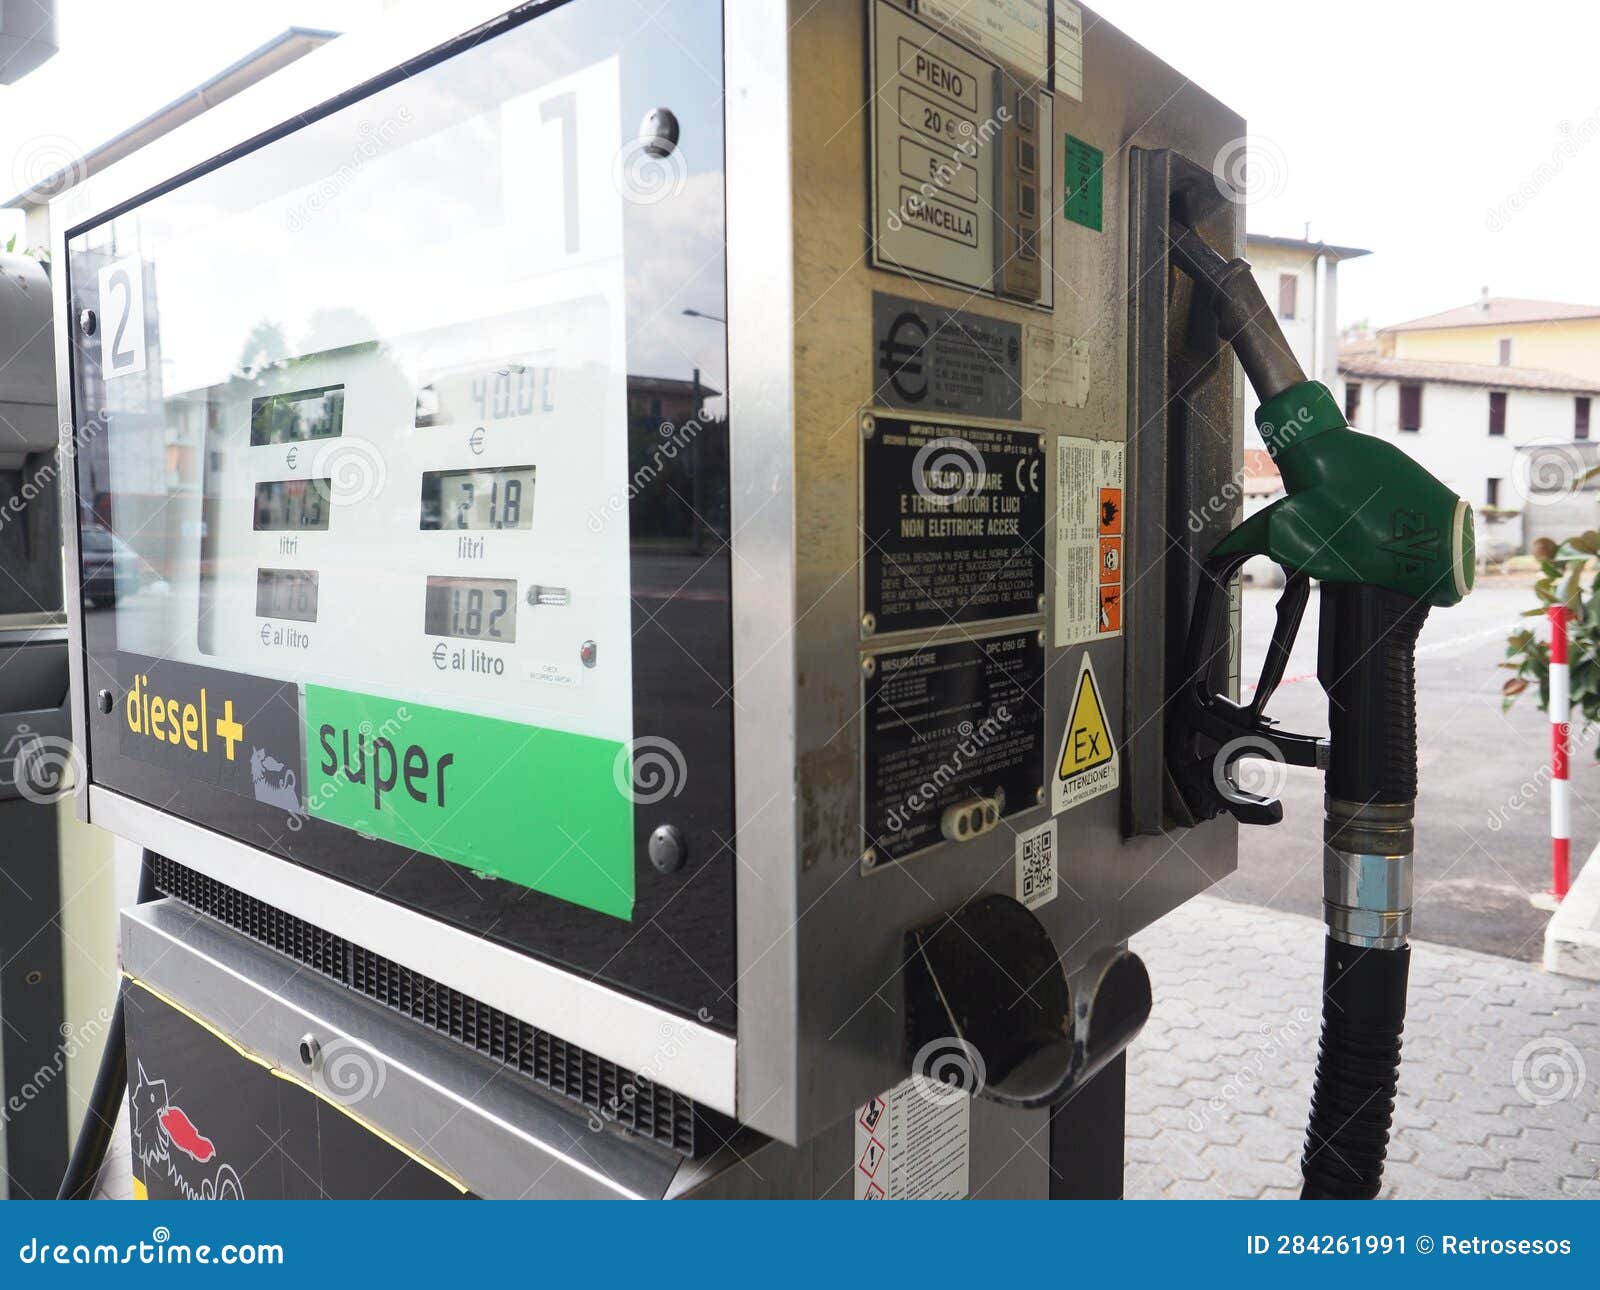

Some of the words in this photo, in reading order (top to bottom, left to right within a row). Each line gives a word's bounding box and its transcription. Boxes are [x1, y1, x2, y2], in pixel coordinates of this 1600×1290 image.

[916, 56, 962, 97] PIENO
[924, 108, 941, 133] 20
[539, 90, 579, 255] 1
[906, 199, 973, 238] CANCELLA
[108, 268, 134, 369] 2
[469, 427, 486, 455] €
[286, 447, 298, 470] €
[965, 471, 1002, 490] FUMARE
[1015, 458, 1039, 492] CE
[901, 494, 907, 513] E
[911, 495, 949, 513] TENERE
[953, 495, 989, 513] MOTORI
[992, 496, 998, 513] E
[1001, 496, 1020, 513] LUCI
[901, 518, 924, 537] NON
[929, 518, 984, 537] ELETTRICHE
[987, 518, 1019, 536] ACCESE
[280, 536, 298, 555] litri
[458, 536, 484, 559] litri
[451, 588, 509, 637] 1.82
[261, 623, 272, 646] €
[273, 628, 284, 647] al
[285, 630, 309, 649] litro
[432, 642, 448, 670] €
[452, 648, 465, 671] al
[472, 651, 504, 675] litro
[126, 673, 208, 752] diesel
[216, 700, 243, 760] +
[1075, 727, 1099, 764] Ex
[320, 724, 454, 810] super
[1063, 766, 1109, 797] ATTENZIONE!
